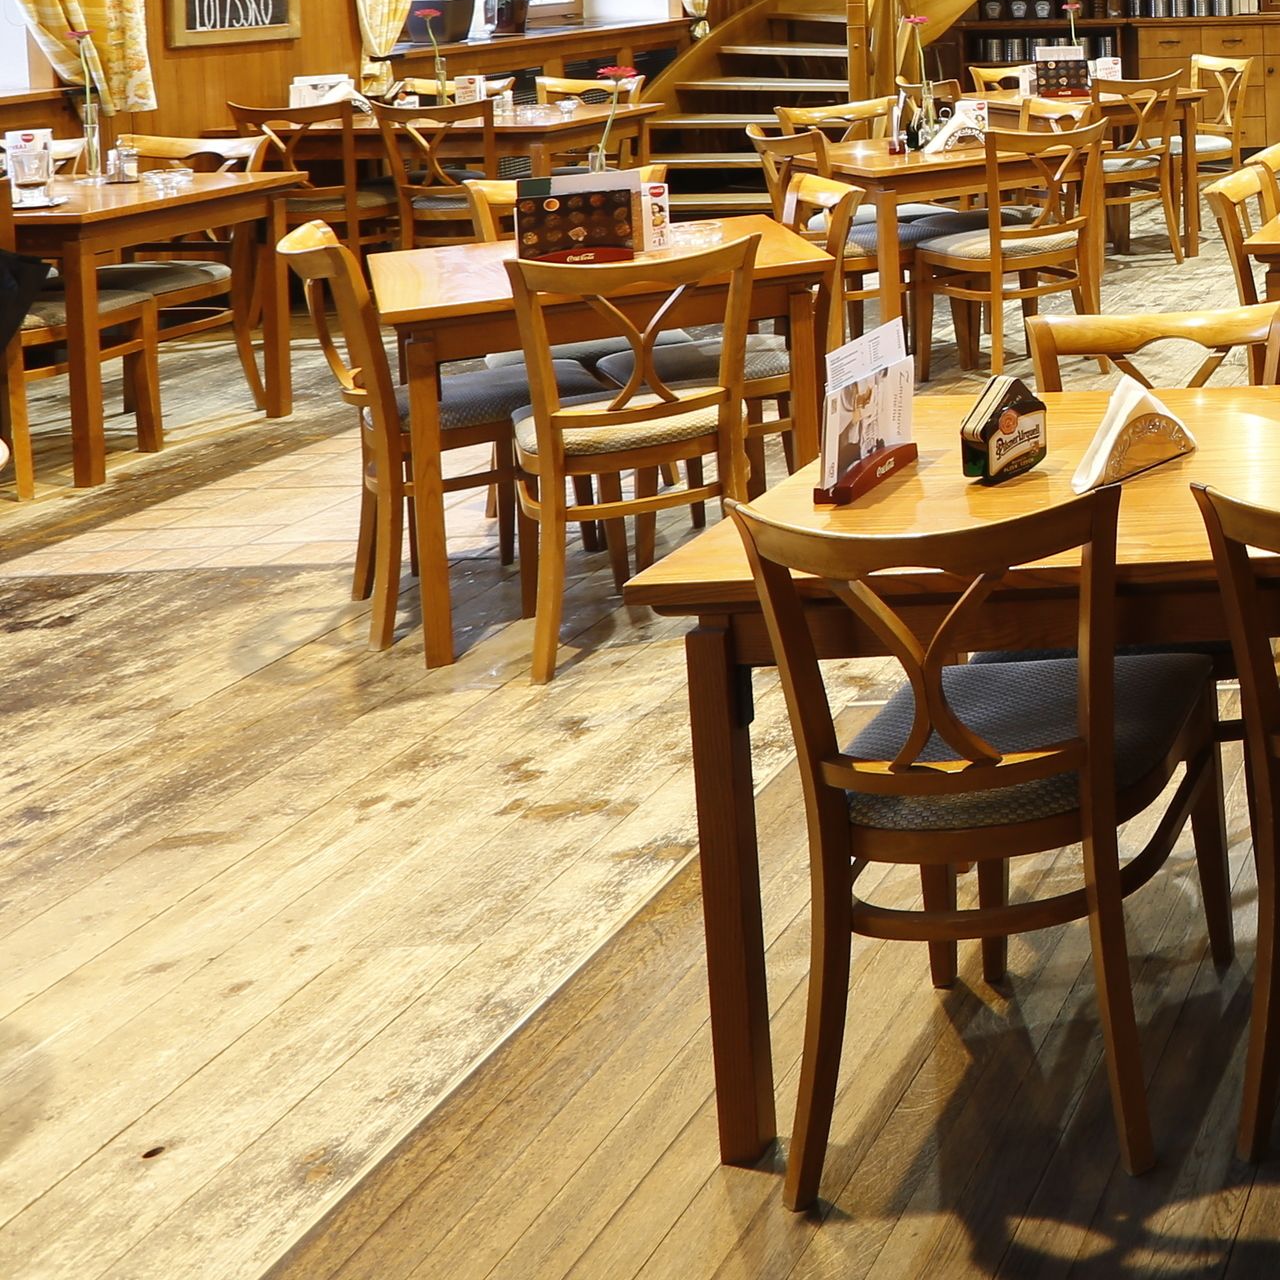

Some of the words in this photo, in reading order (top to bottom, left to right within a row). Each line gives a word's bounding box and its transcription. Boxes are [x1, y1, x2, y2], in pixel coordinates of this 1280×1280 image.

[566, 252, 595, 263] Coca-Cola
[995, 434, 1019, 461] Pilsner
[1017, 423, 1040, 442] Urquell
[876, 457, 895, 477] Coca-Cola
